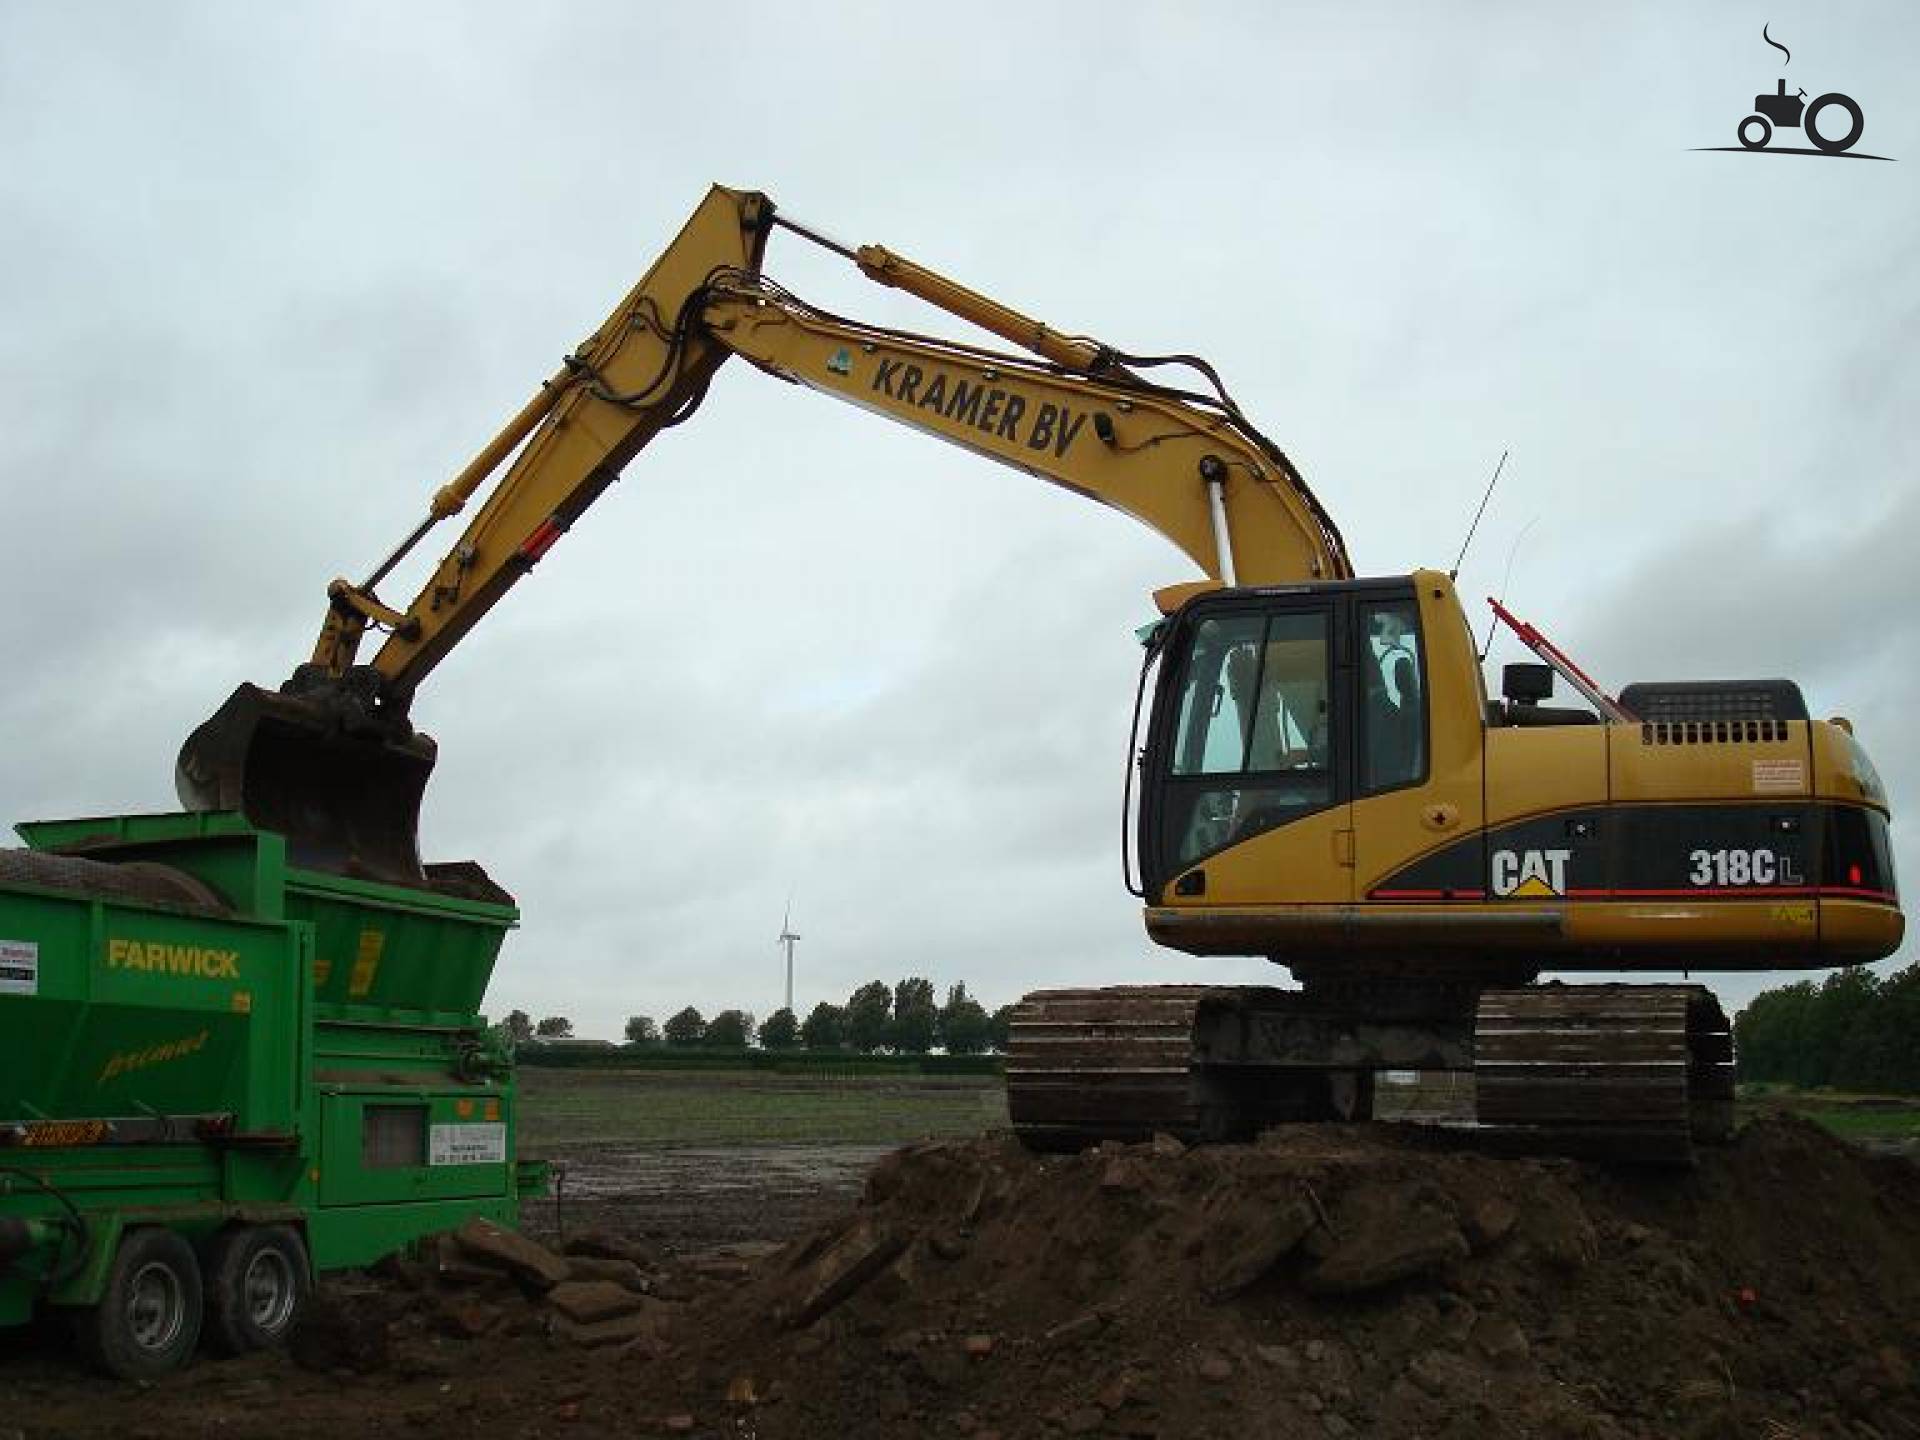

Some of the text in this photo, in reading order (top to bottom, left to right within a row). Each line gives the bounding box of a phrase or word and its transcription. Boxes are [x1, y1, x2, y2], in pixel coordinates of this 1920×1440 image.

[872, 359, 1086, 458] KRAMER BV
[1492, 849, 1571, 896] CAT
[1689, 849, 1776, 886] 318C
[108, 938, 241, 979] FARWICK
